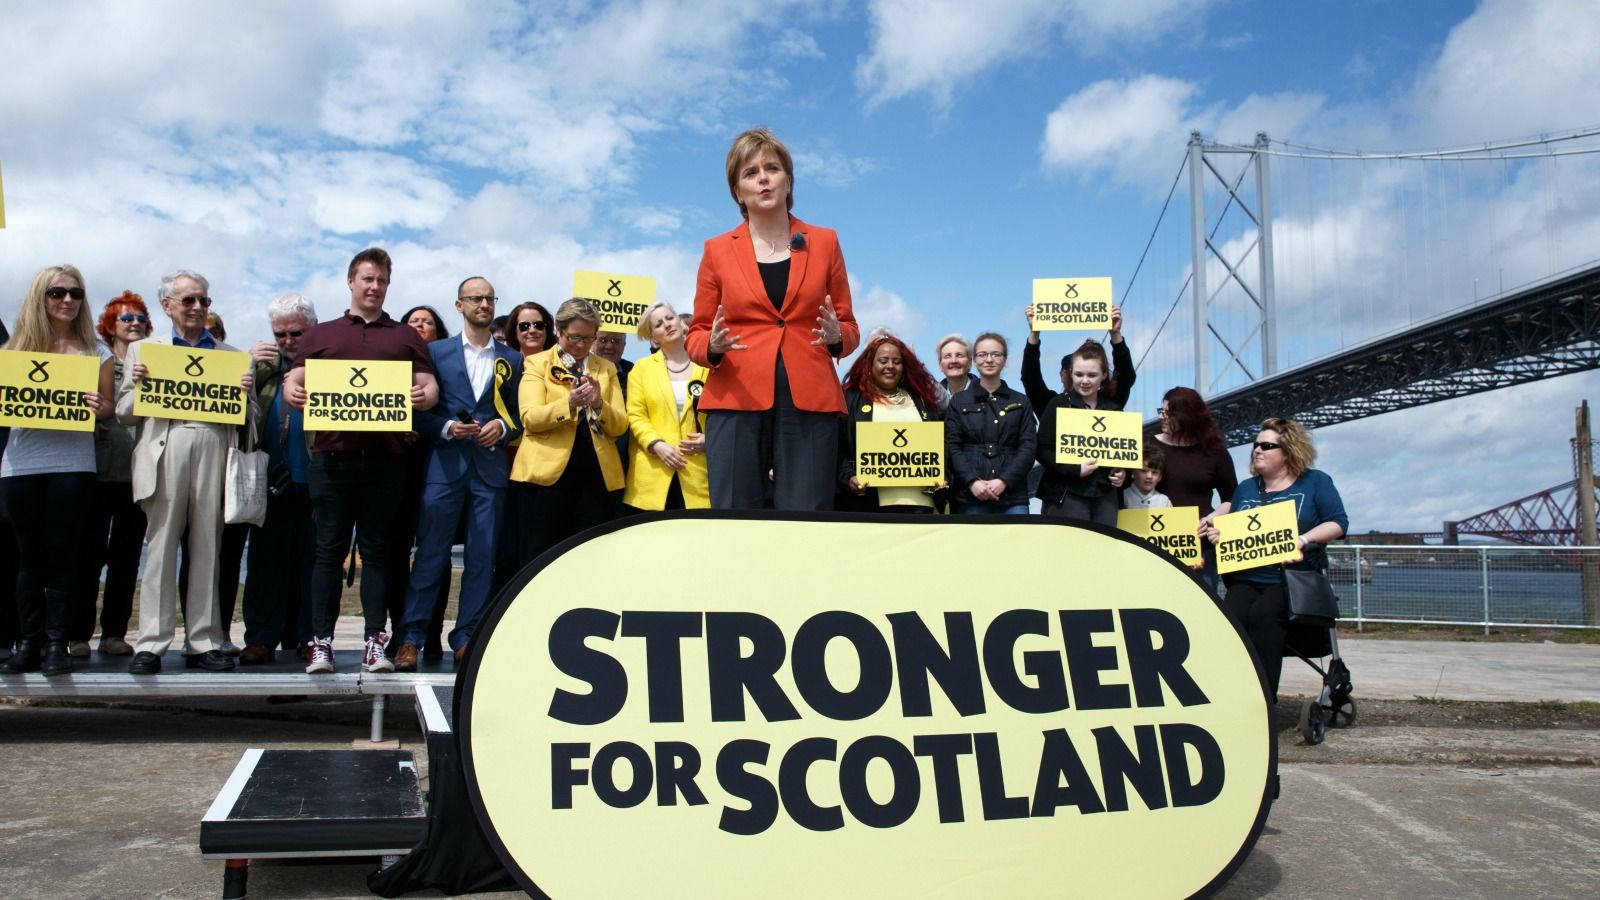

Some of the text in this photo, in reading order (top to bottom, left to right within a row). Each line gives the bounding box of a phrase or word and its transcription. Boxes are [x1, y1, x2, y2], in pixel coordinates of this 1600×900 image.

[584, 298, 648, 316] RONGE
[1036, 302, 1108, 314] STRONGER
[599, 313, 640, 326] COTLAN
[1051, 314, 1109, 323] SCOTLAND
[140, 377, 242, 401] STRONGER
[140, 394, 242, 415] FOR SCOTLAND
[309, 392, 406, 408] STRONGER
[4, 403, 91, 422] SCOTLAND
[309, 408, 407, 421] FOR SCOTLAND
[1060, 434, 1137, 450] STRONGER
[860, 452, 940, 466] STRONGER
[1077, 448, 1139, 461] SCOTLAND
[860, 467, 940, 478] FOR SCOTLAND
[1146, 535, 1197, 548] ONGER
[1220, 528, 1293, 554] STRONGER
[1220, 542, 1295, 562] FOR SCOTLAND
[547, 607, 1210, 726] STRONGER
[550, 722, 1226, 836] FOR SCOTLAND
